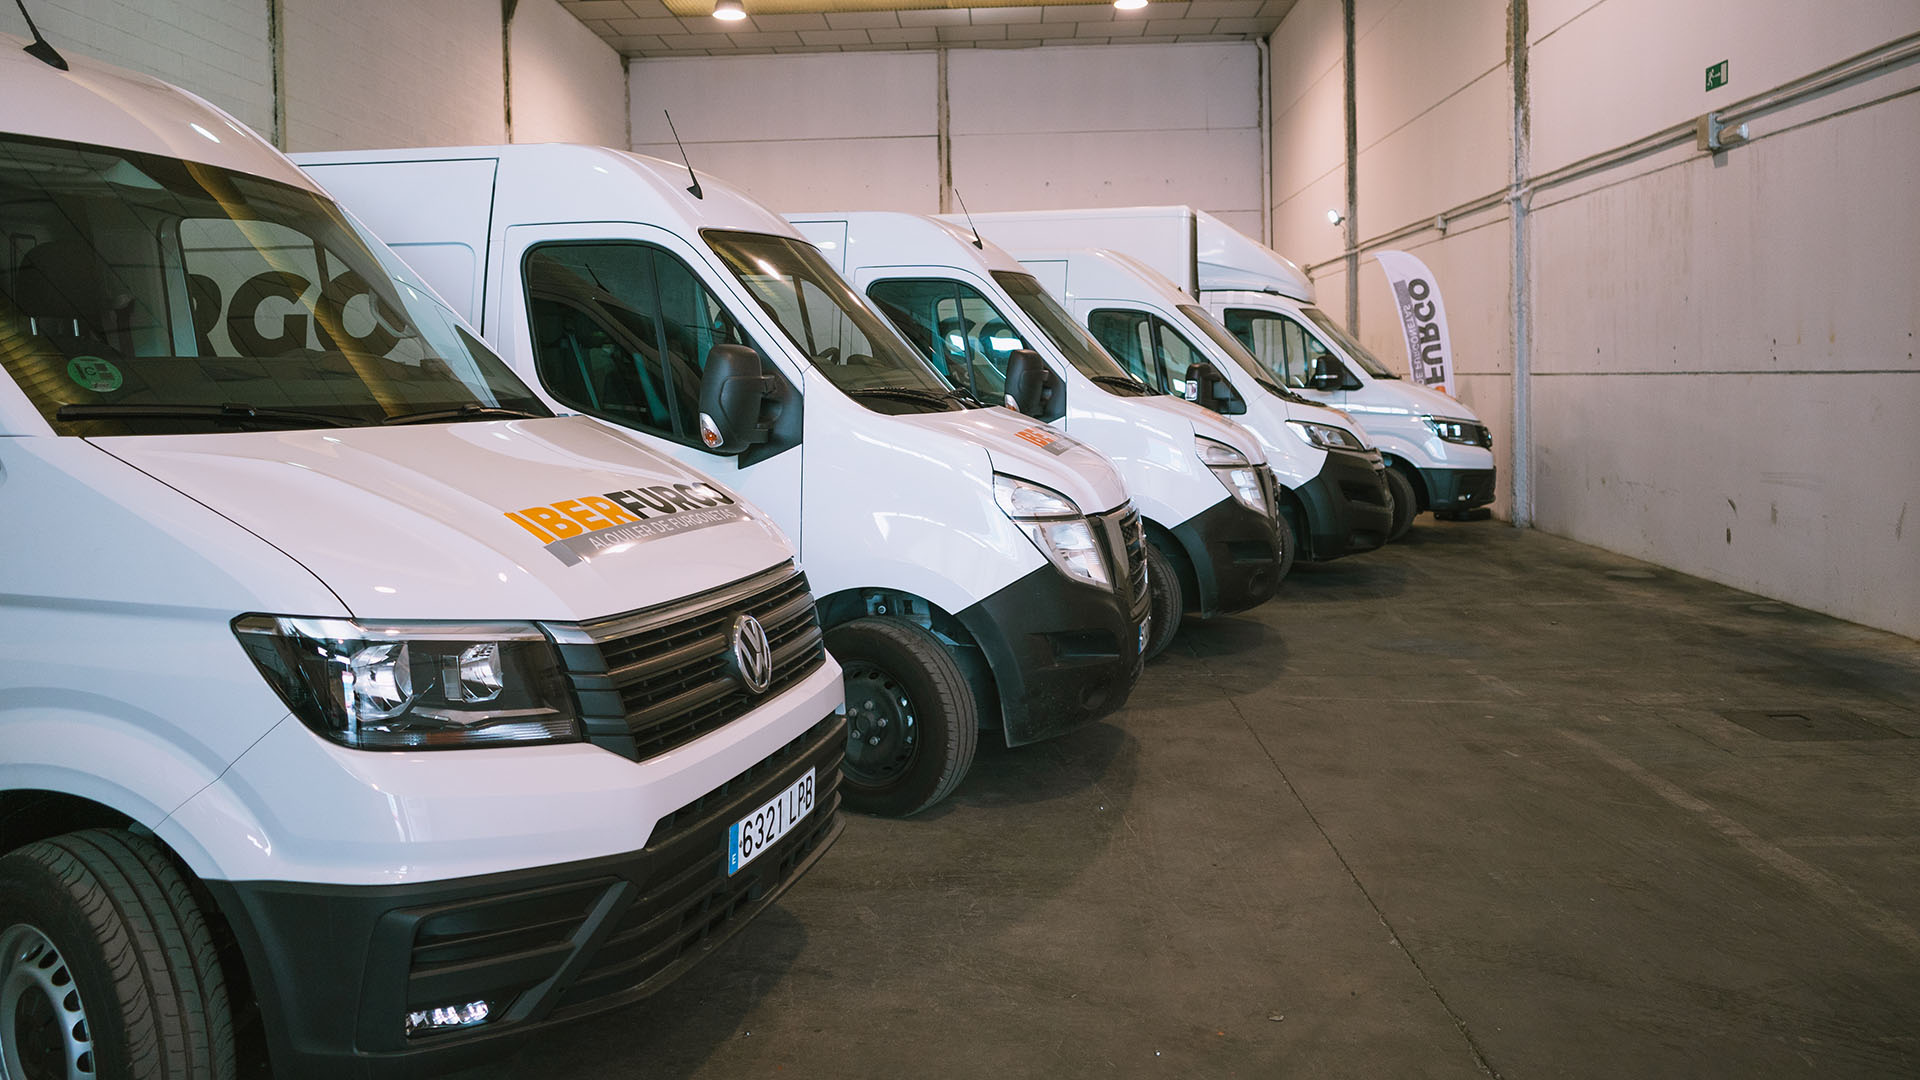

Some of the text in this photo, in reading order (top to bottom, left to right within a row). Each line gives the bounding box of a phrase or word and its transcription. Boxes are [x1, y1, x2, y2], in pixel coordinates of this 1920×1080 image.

[588, 508, 737, 550] ALQUILER DE FURGONETAS
[742, 775, 813, 858] 6321 LPB
